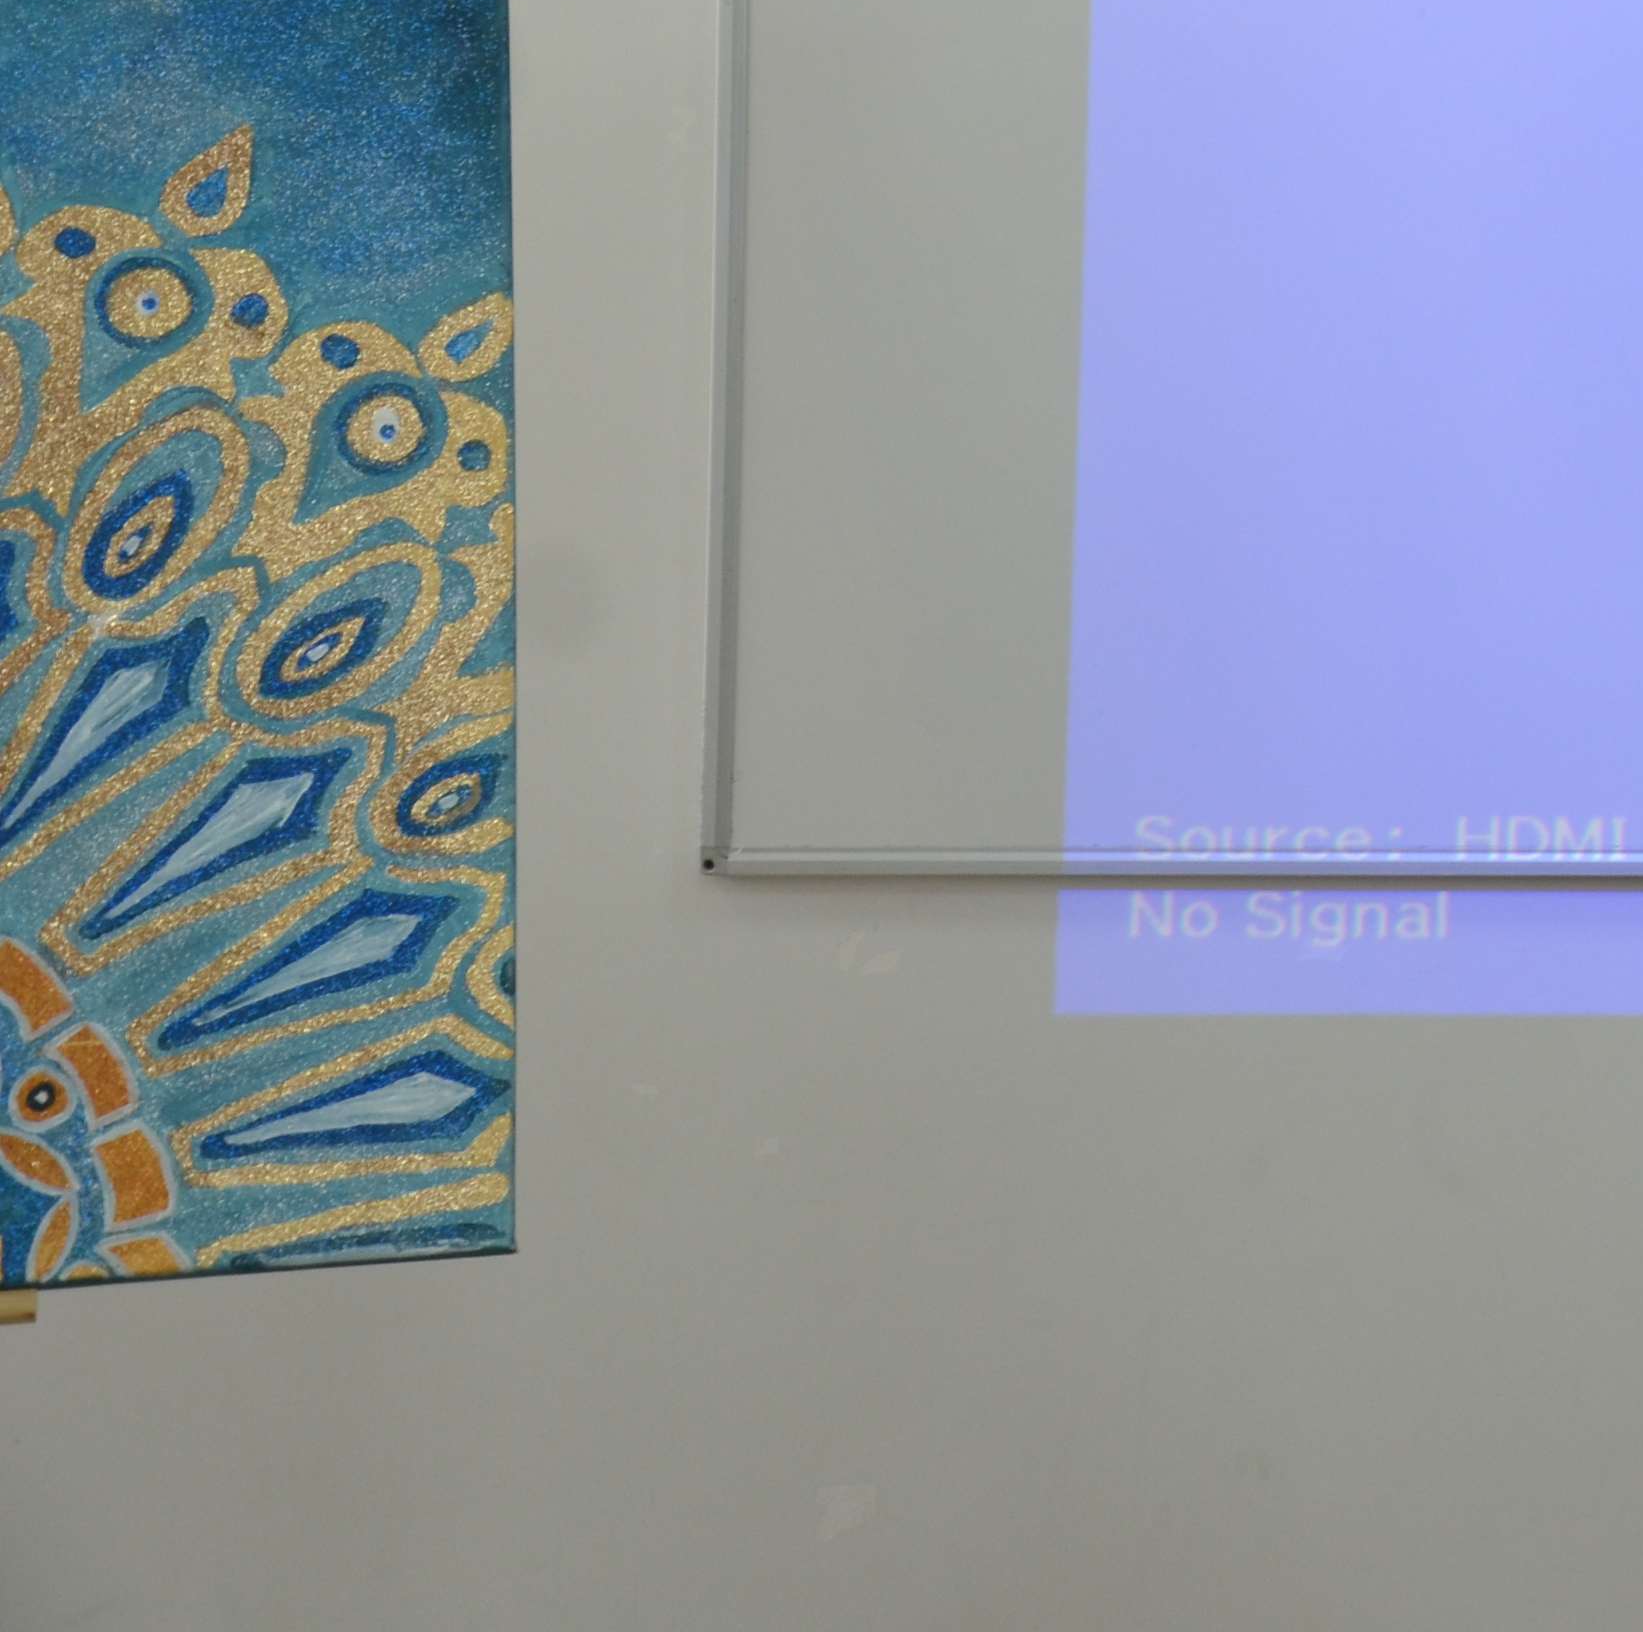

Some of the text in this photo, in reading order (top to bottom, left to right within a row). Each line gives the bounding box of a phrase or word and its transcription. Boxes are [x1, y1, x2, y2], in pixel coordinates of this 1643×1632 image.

[1134, 815, 1628, 862] Source: HDMI
[1127, 890, 1450, 948] No Signal
